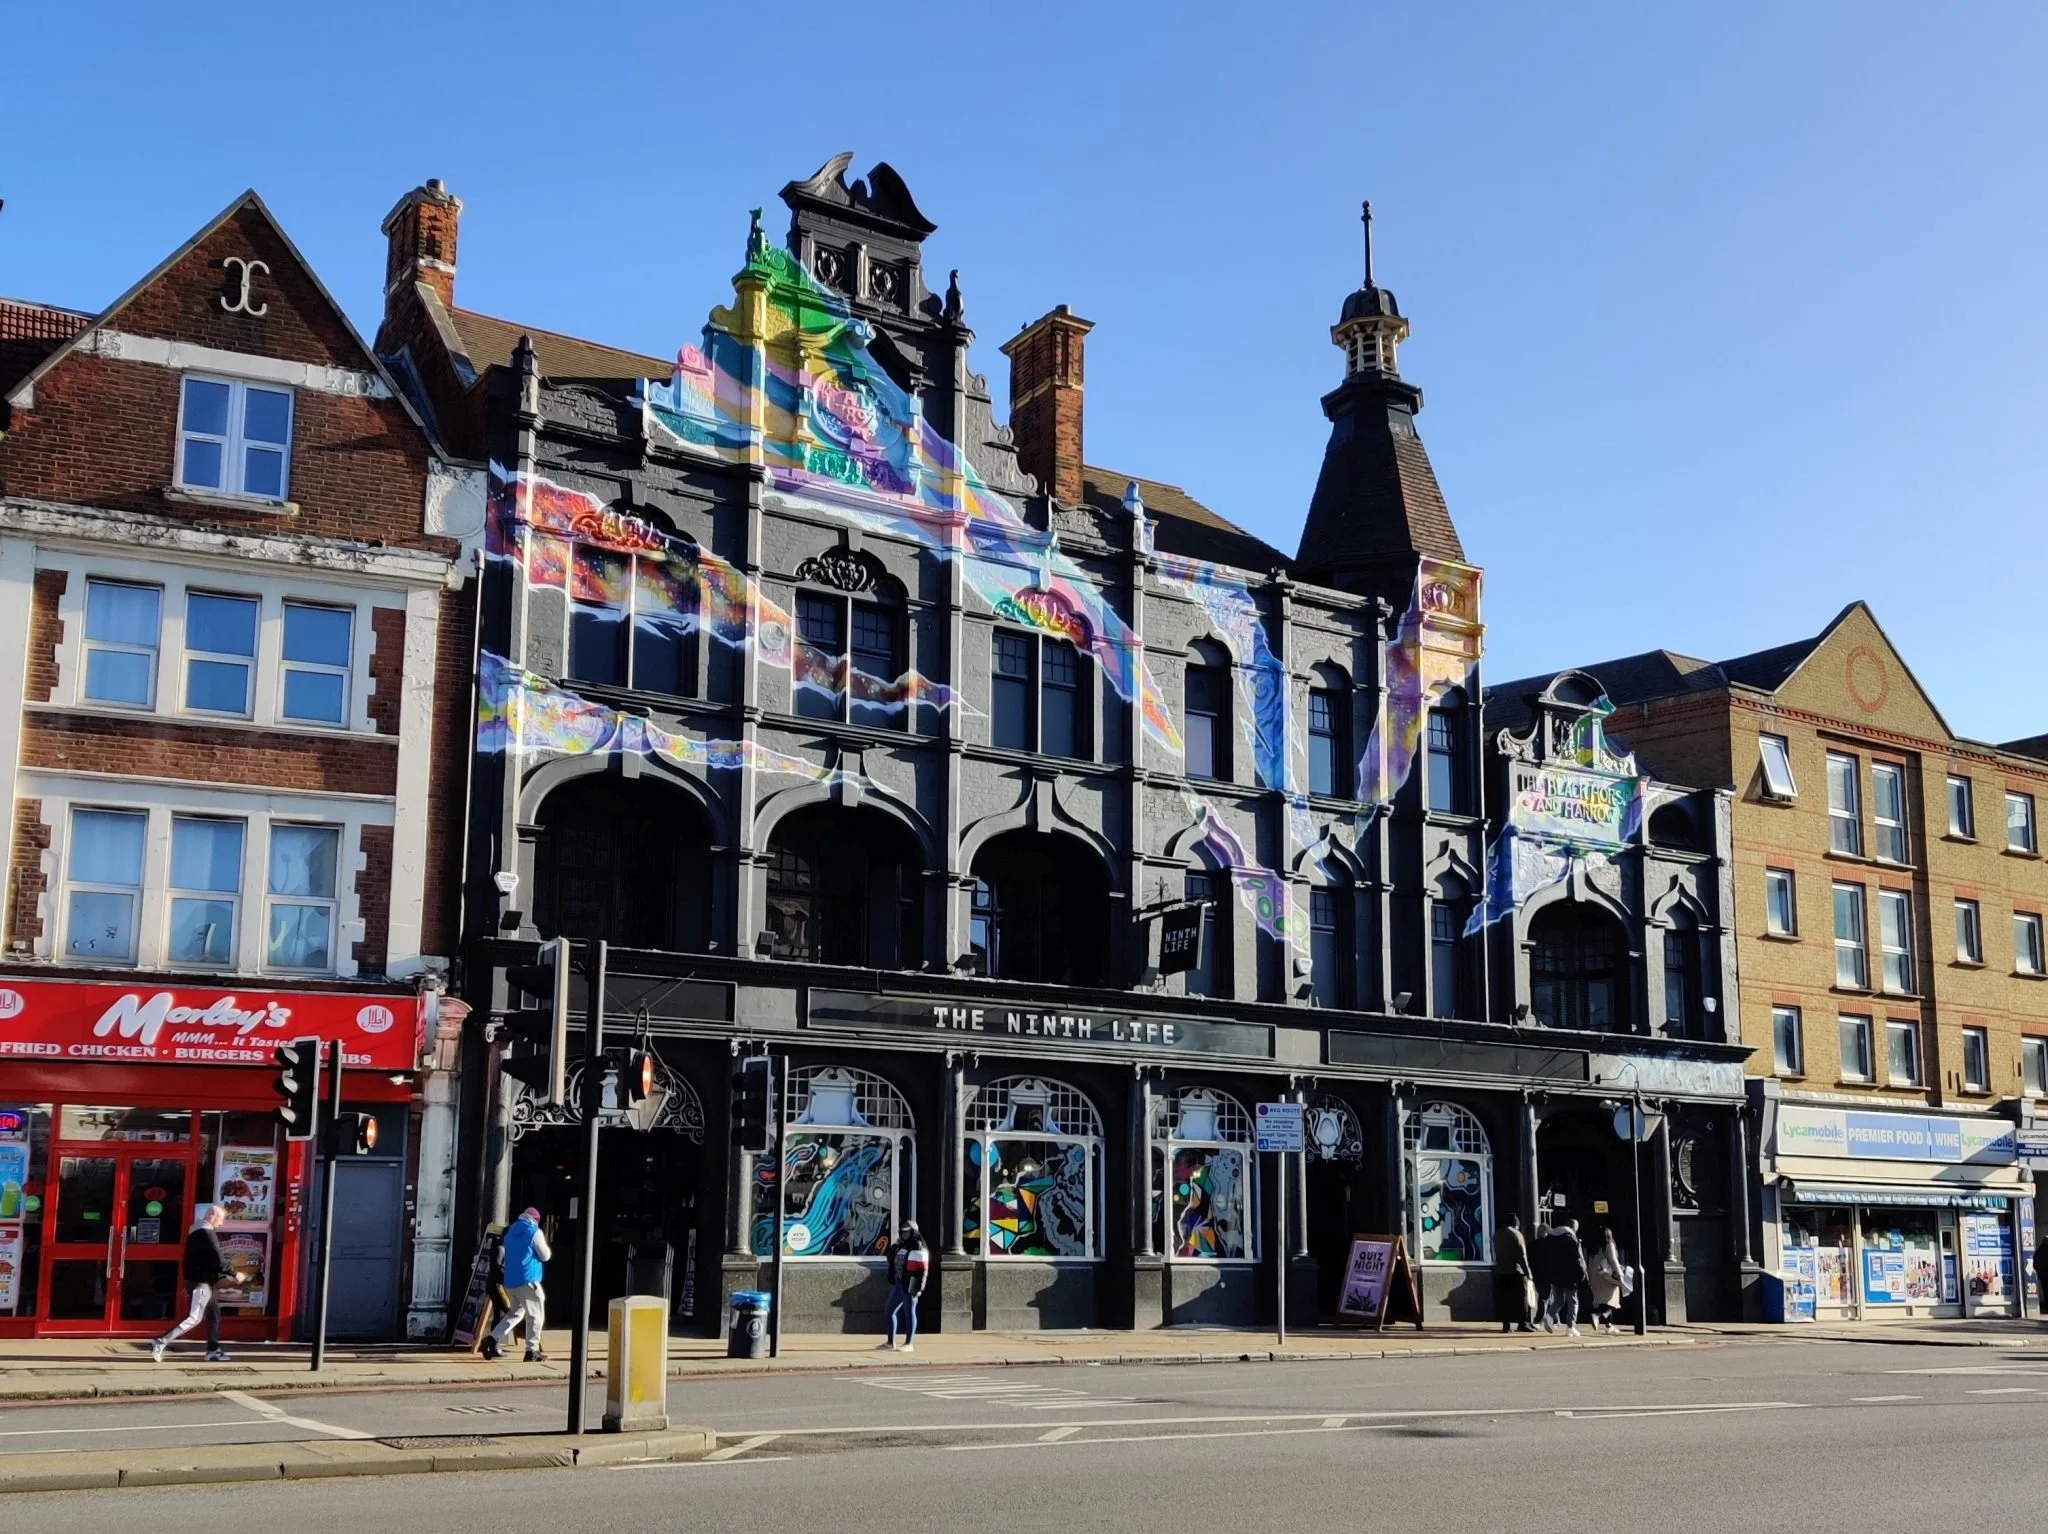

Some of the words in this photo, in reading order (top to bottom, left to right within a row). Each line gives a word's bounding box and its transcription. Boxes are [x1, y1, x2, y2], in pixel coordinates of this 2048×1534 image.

[1547, 774, 1591, 801] BLACK
[1535, 798, 1559, 813] AND
[1165, 927, 1197, 942] NINTH
[1164, 939, 1189, 953] LIFE
[93, 992, 292, 1046] Morley's
[933, 1006, 985, 1031] THE
[1007, 1012, 1091, 1039] NINTH
[1112, 1020, 1175, 1045] LIFE
[232, 1036, 247, 1046] It
[0, 1042, 61, 1055] FRIED
[67, 1044, 157, 1057] CHICKEN
[174, 1048, 265, 1061] BURGERS
[339, 1053, 372, 1065] IBS
[1783, 1121, 1844, 1138] Lycamobile
[1848, 1127, 1895, 1144] PREMIER
[1896, 1130, 1923, 1146] FOOD
[1934, 1132, 1960, 1148] WINE
[1960, 1133, 2013, 1149] Lycamobile
[1359, 1251, 1384, 1262] QUIZ
[1354, 1260, 1385, 1272] NIGHT
